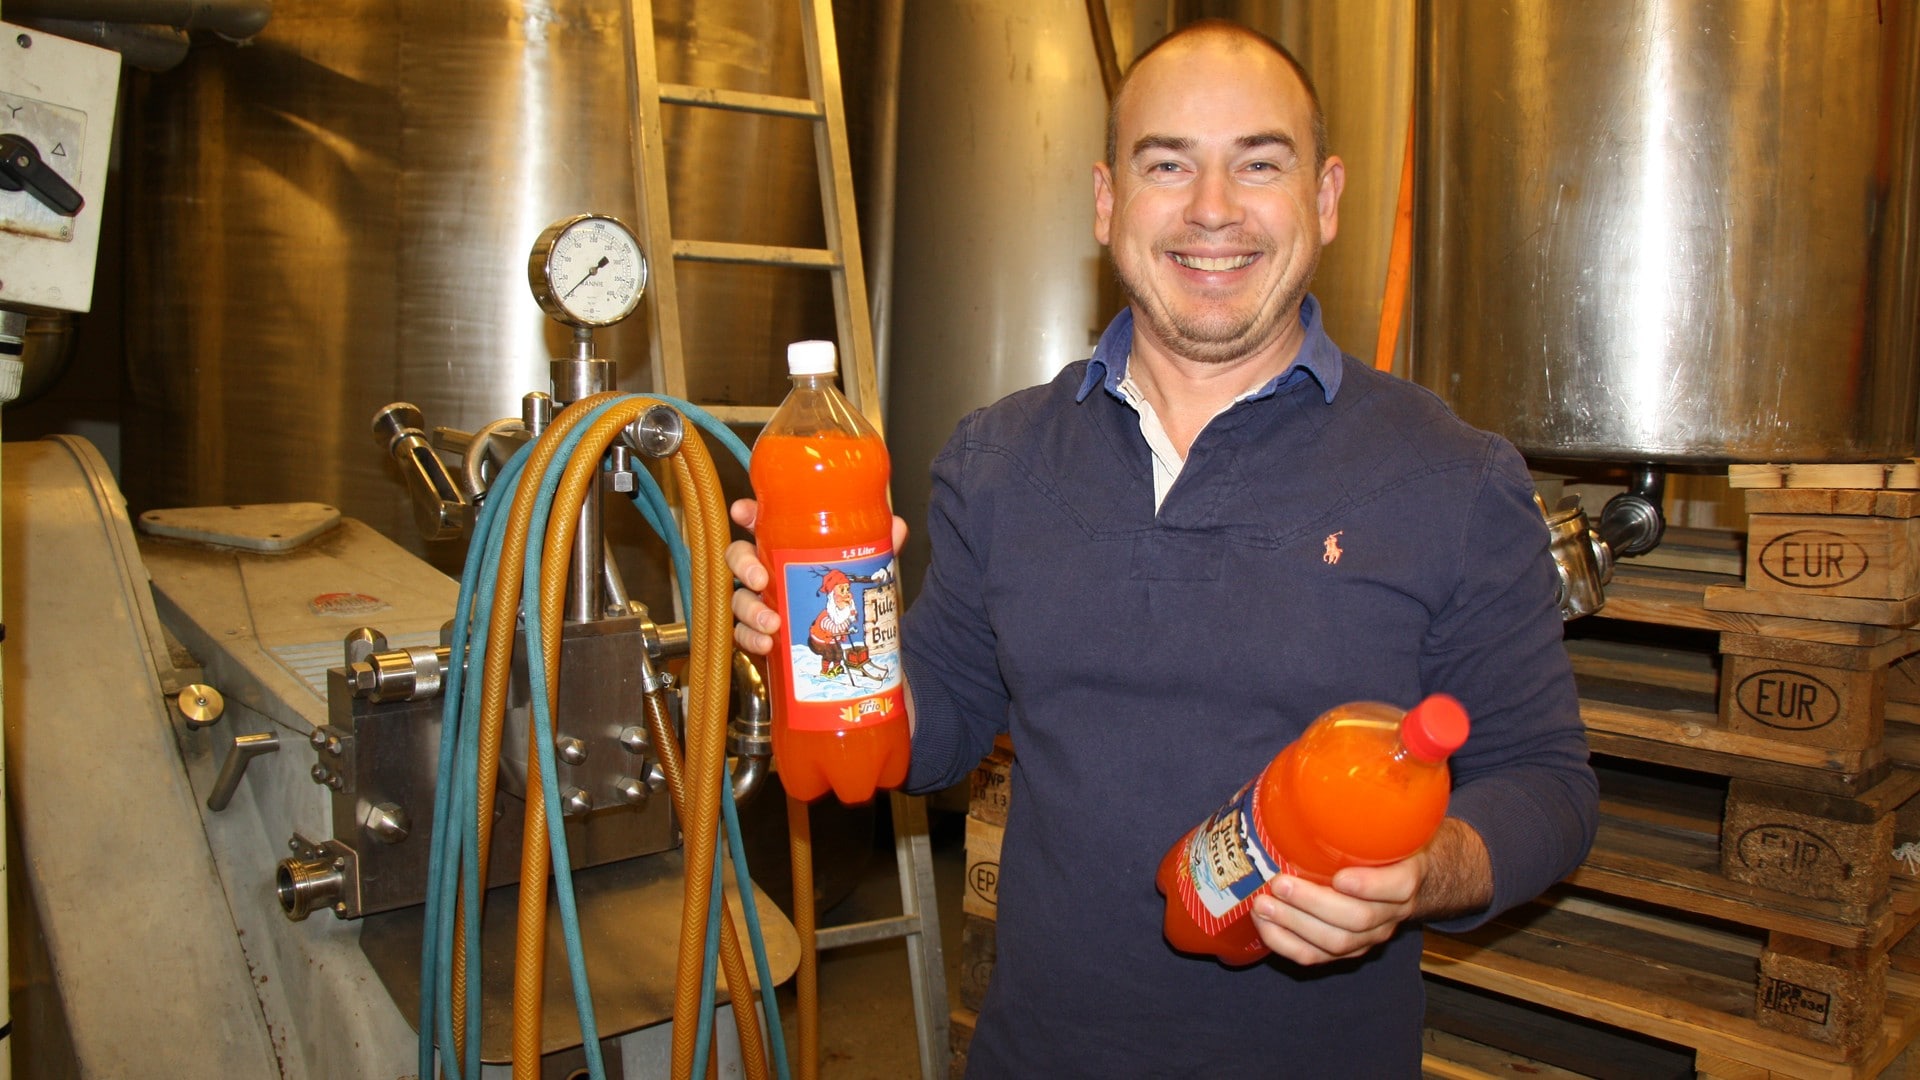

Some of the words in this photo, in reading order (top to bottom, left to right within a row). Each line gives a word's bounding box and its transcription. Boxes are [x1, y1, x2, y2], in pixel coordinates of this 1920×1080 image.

[842, 548, 856, 559] 1,5
[857, 546, 876, 556] Liter
[1782, 542, 1844, 578] EUR
[872, 626, 897, 643] Brus
[859, 700, 881, 714] Trio
[1756, 678, 1817, 722] EUR
[1211, 831, 1225, 876] Brus
[977, 868, 998, 896] EP
